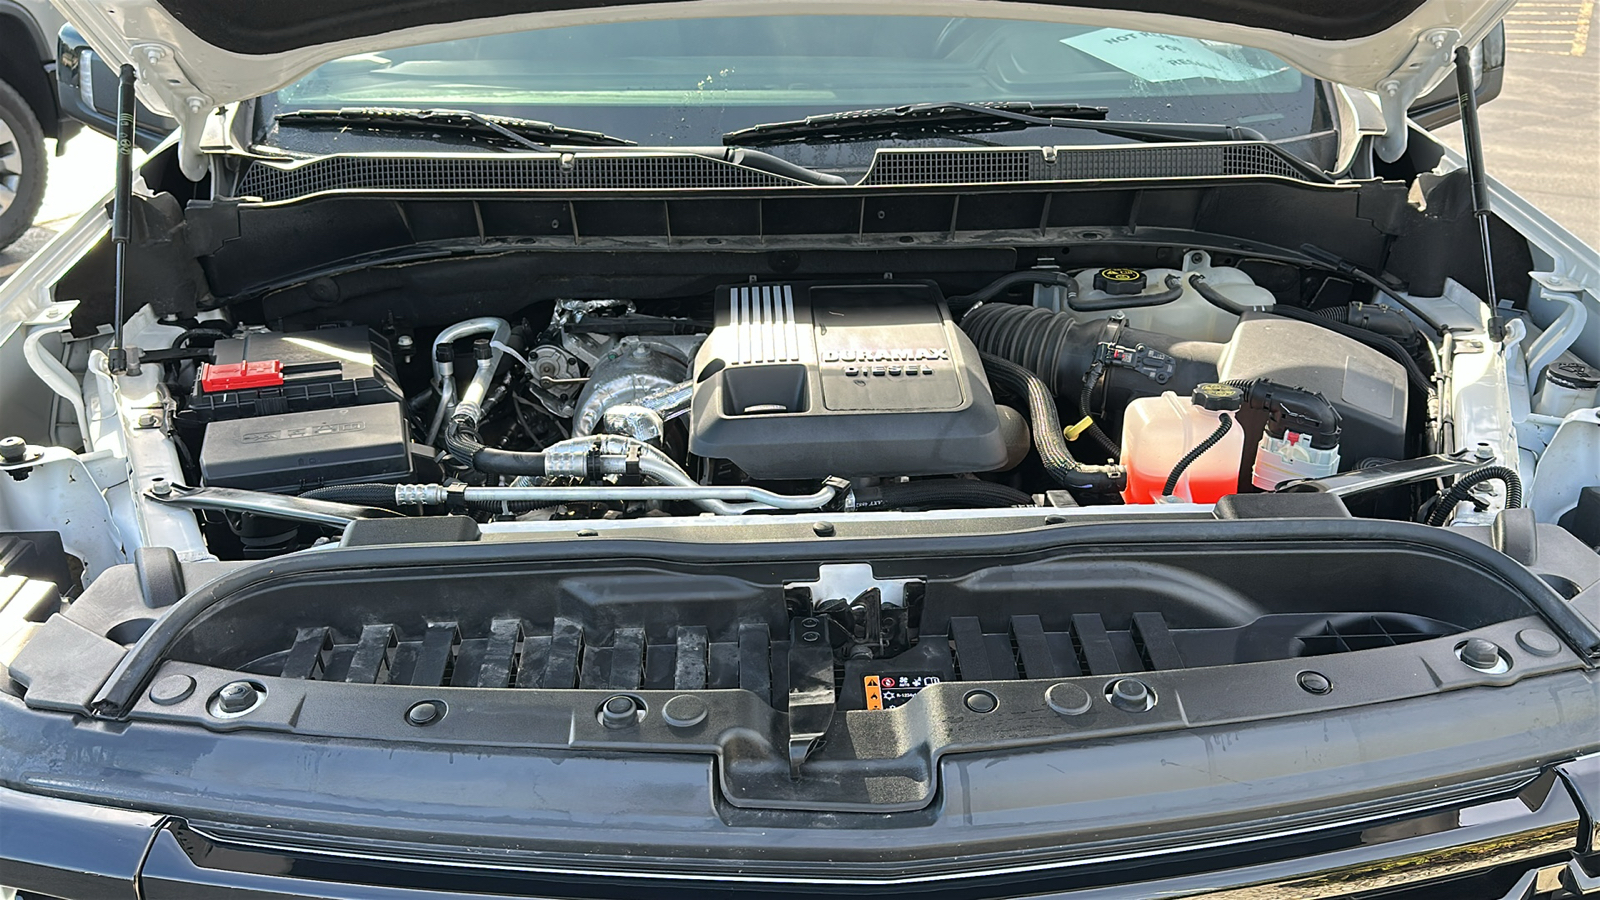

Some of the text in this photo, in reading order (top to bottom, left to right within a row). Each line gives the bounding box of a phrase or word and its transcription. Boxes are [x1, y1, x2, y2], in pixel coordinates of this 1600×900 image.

[1104, 33, 1137, 44] NOT
[822, 348, 949, 363] DURAMAX
[844, 364, 934, 377] DIESEL
